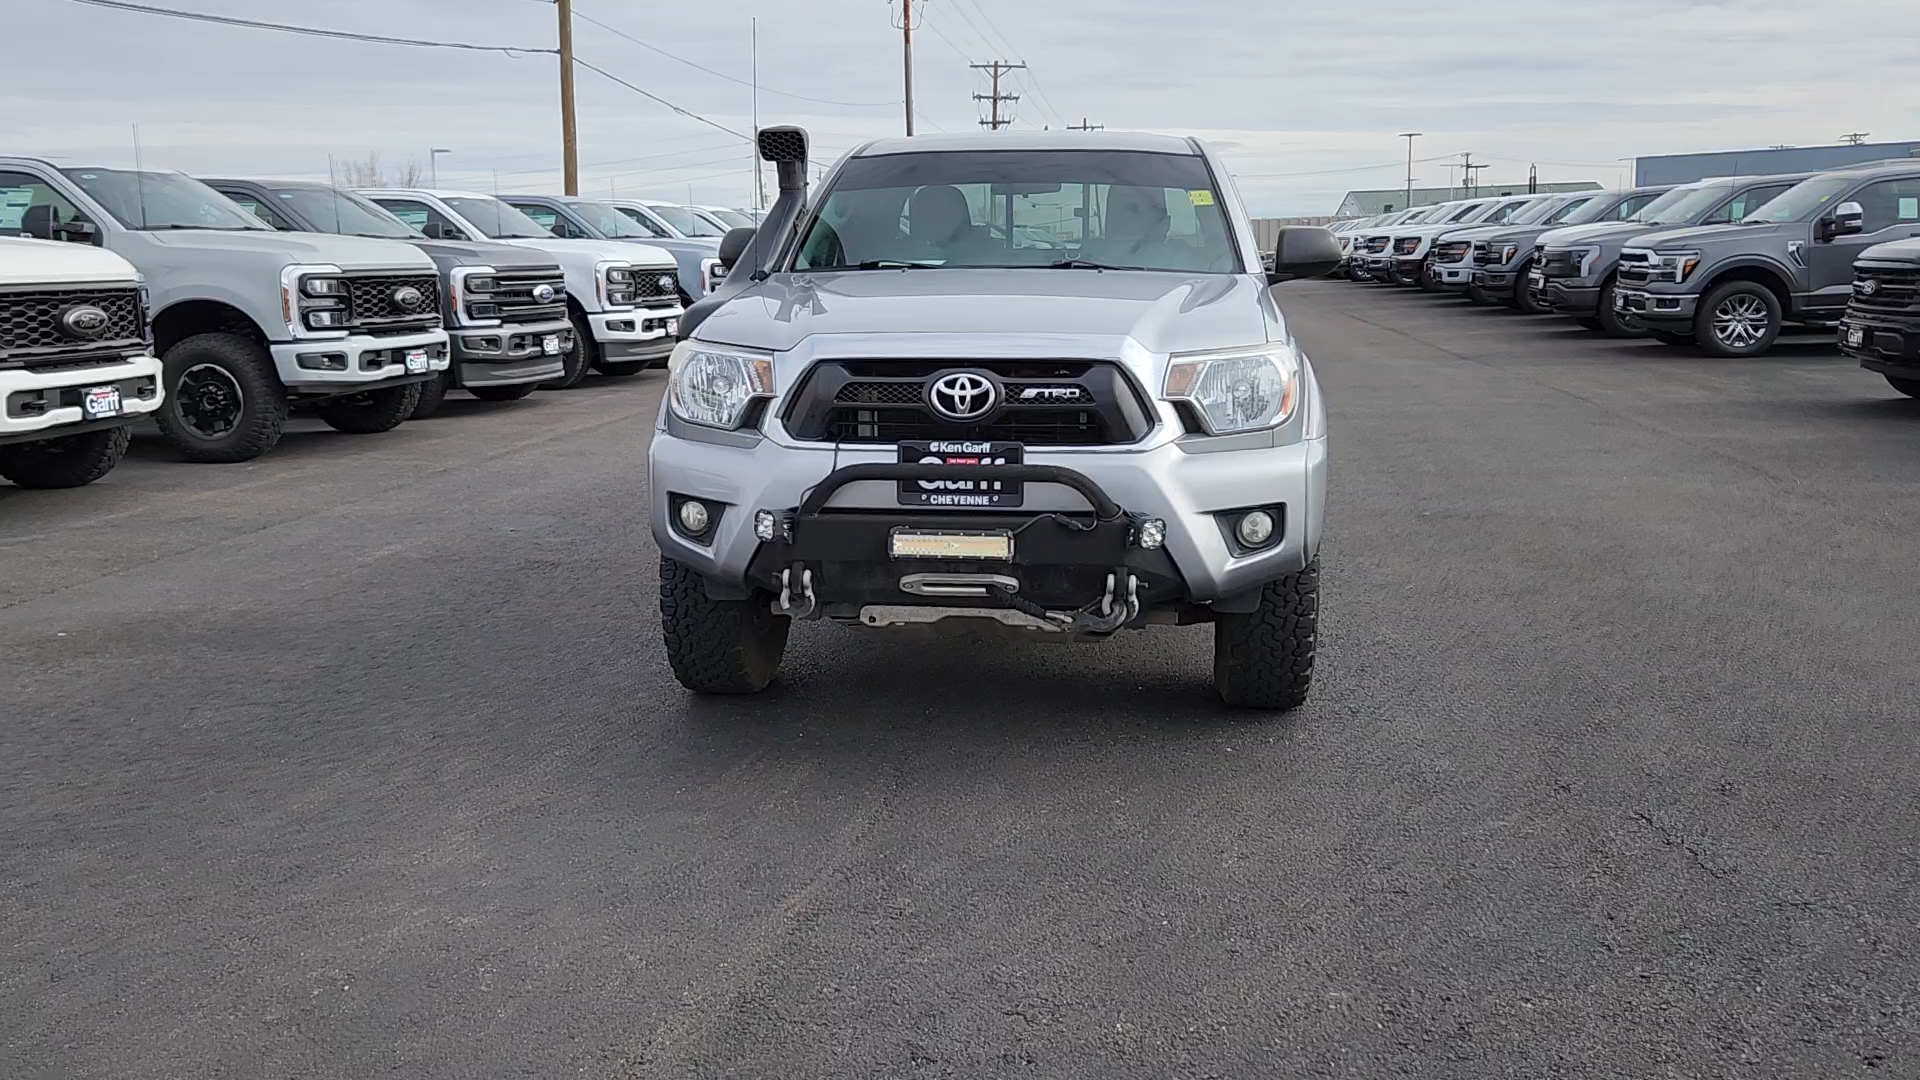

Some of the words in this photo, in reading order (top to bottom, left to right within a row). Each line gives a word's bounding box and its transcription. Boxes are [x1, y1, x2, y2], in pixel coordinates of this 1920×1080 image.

[1044, 388, 1080, 399] TRD
[86, 391, 120, 414] Garff
[940, 442, 961, 453] Ken
[963, 442, 991, 453] Garff
[930, 495, 990, 505] CHEYENNE
